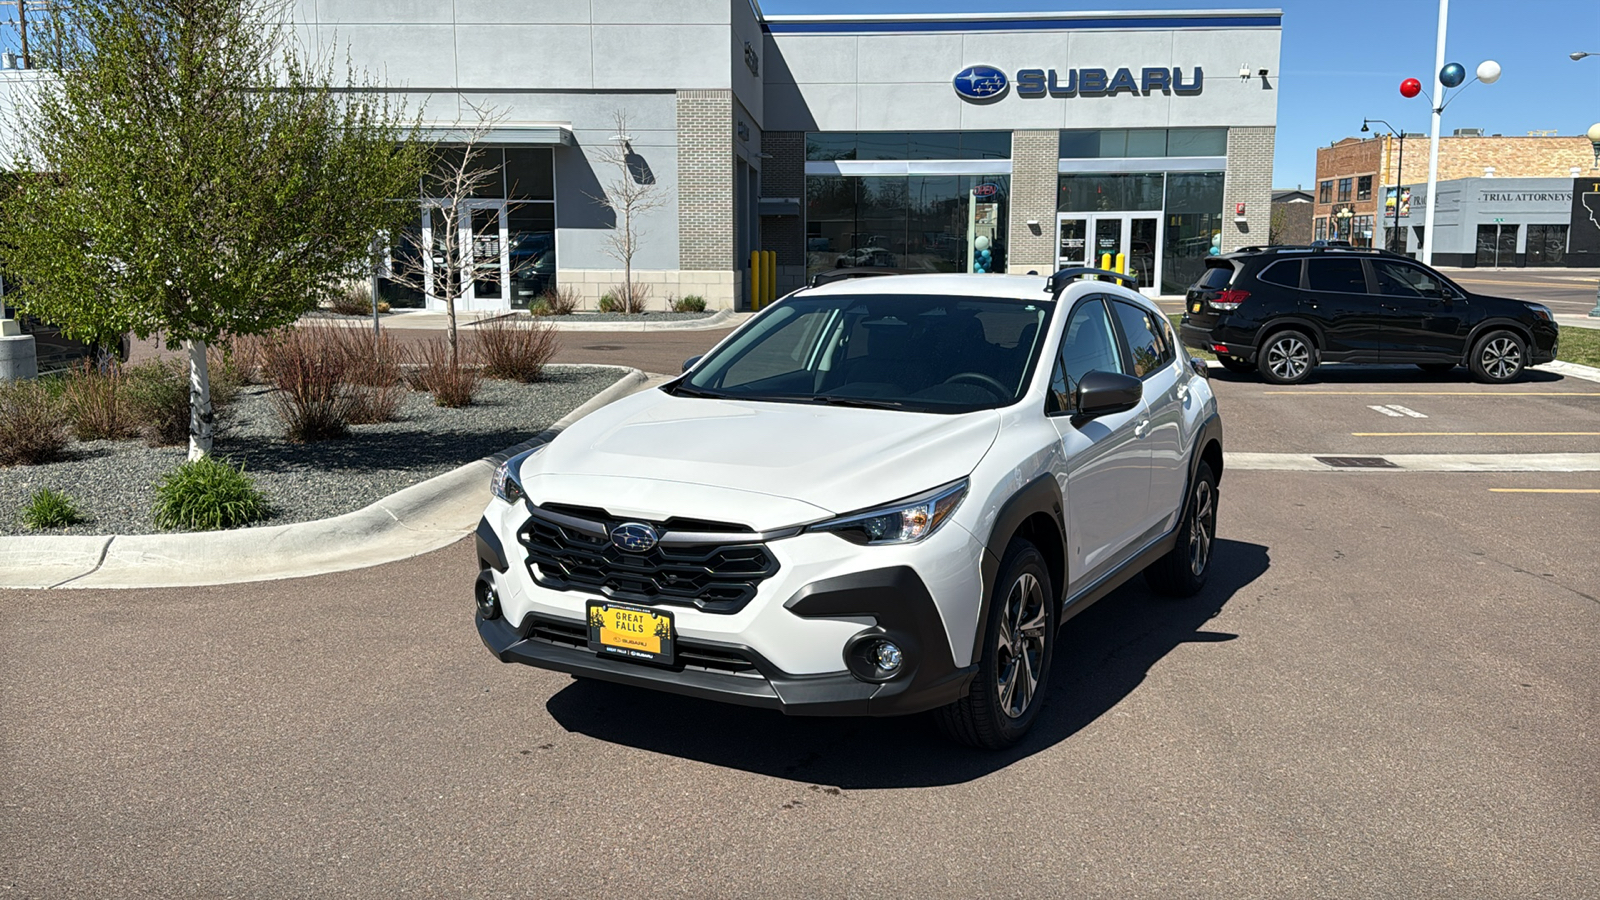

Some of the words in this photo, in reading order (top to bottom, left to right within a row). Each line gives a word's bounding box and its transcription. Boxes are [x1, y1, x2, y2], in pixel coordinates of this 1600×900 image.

[1016, 66, 1203, 97] SUBARU
[973, 185, 997, 196] OPEN
[1483, 193, 1513, 202] TRIAL
[1515, 193, 1572, 202] ATTORNEYS
[616, 612, 644, 623] GREAT
[616, 621, 644, 633] FALLS
[622, 639, 647, 647] SUBARU
